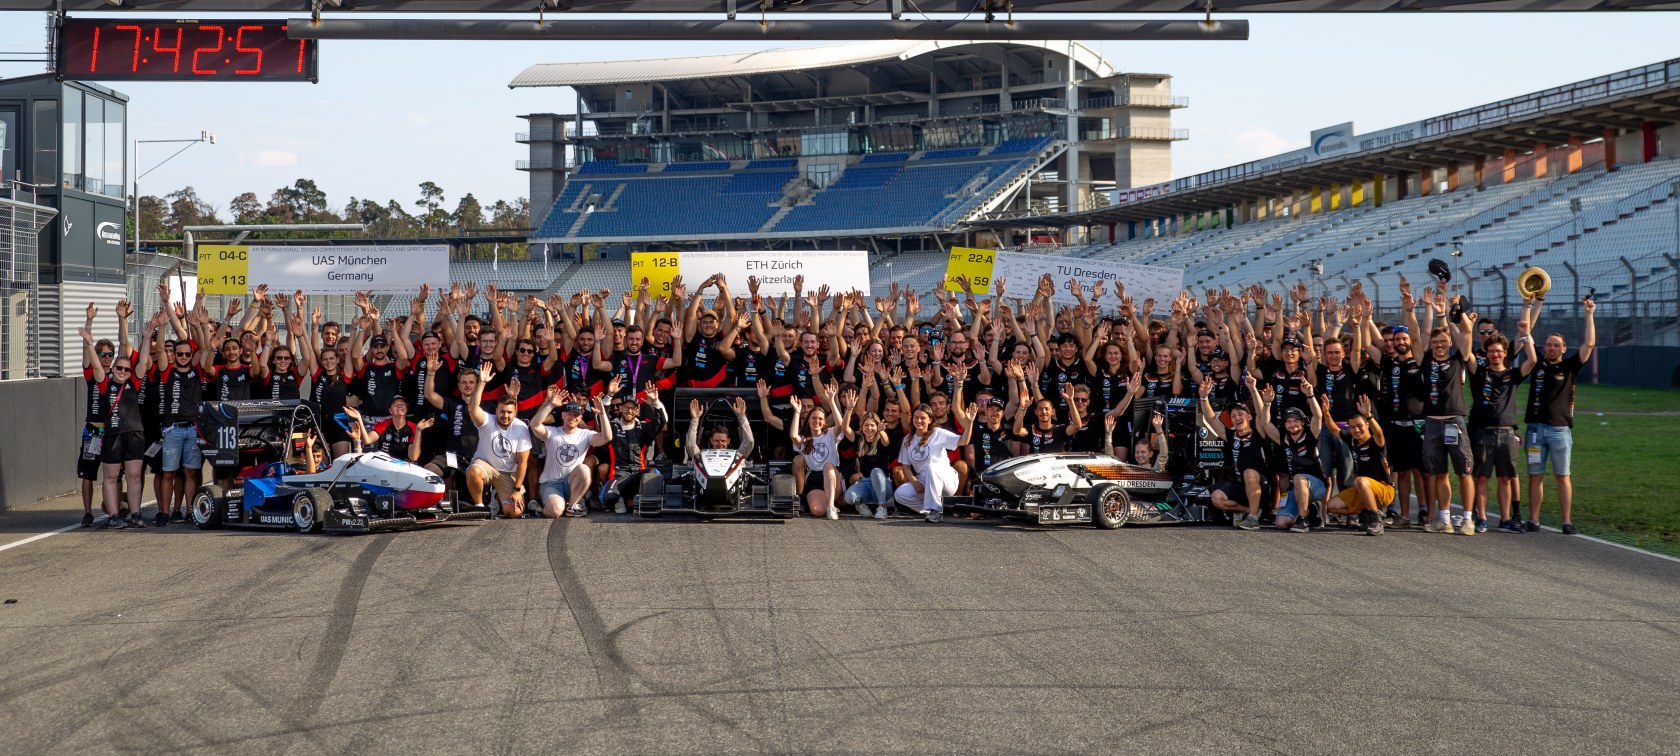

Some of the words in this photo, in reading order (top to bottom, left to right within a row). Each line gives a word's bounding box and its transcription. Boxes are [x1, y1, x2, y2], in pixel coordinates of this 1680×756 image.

[1376, 135, 1391, 148] THAN
[1119, 184, 1170, 204] PORSCE
[219, 250, 247, 261] 04-C
[312, 255, 335, 266] UAS
[338, 255, 387, 266] München
[968, 253, 993, 264] 22-A
[633, 260, 644, 268] PIT
[652, 257, 678, 267] 12-B
[746, 260, 768, 270] ETH
[771, 260, 803, 270] Zürich
[327, 271, 374, 283] Germany
[1057, 265, 1071, 276] TU
[1074, 269, 1117, 280] Dresden
[198, 277, 214, 285] CAR
[221, 275, 246, 286] 113
[749, 274, 804, 284] witzerla
[973, 276, 989, 287] 59
[217, 426, 237, 450] 113
[1117, 480, 1126, 488] TU
[1127, 480, 1156, 488] DRESDEN
[260, 515, 271, 523] UAS
